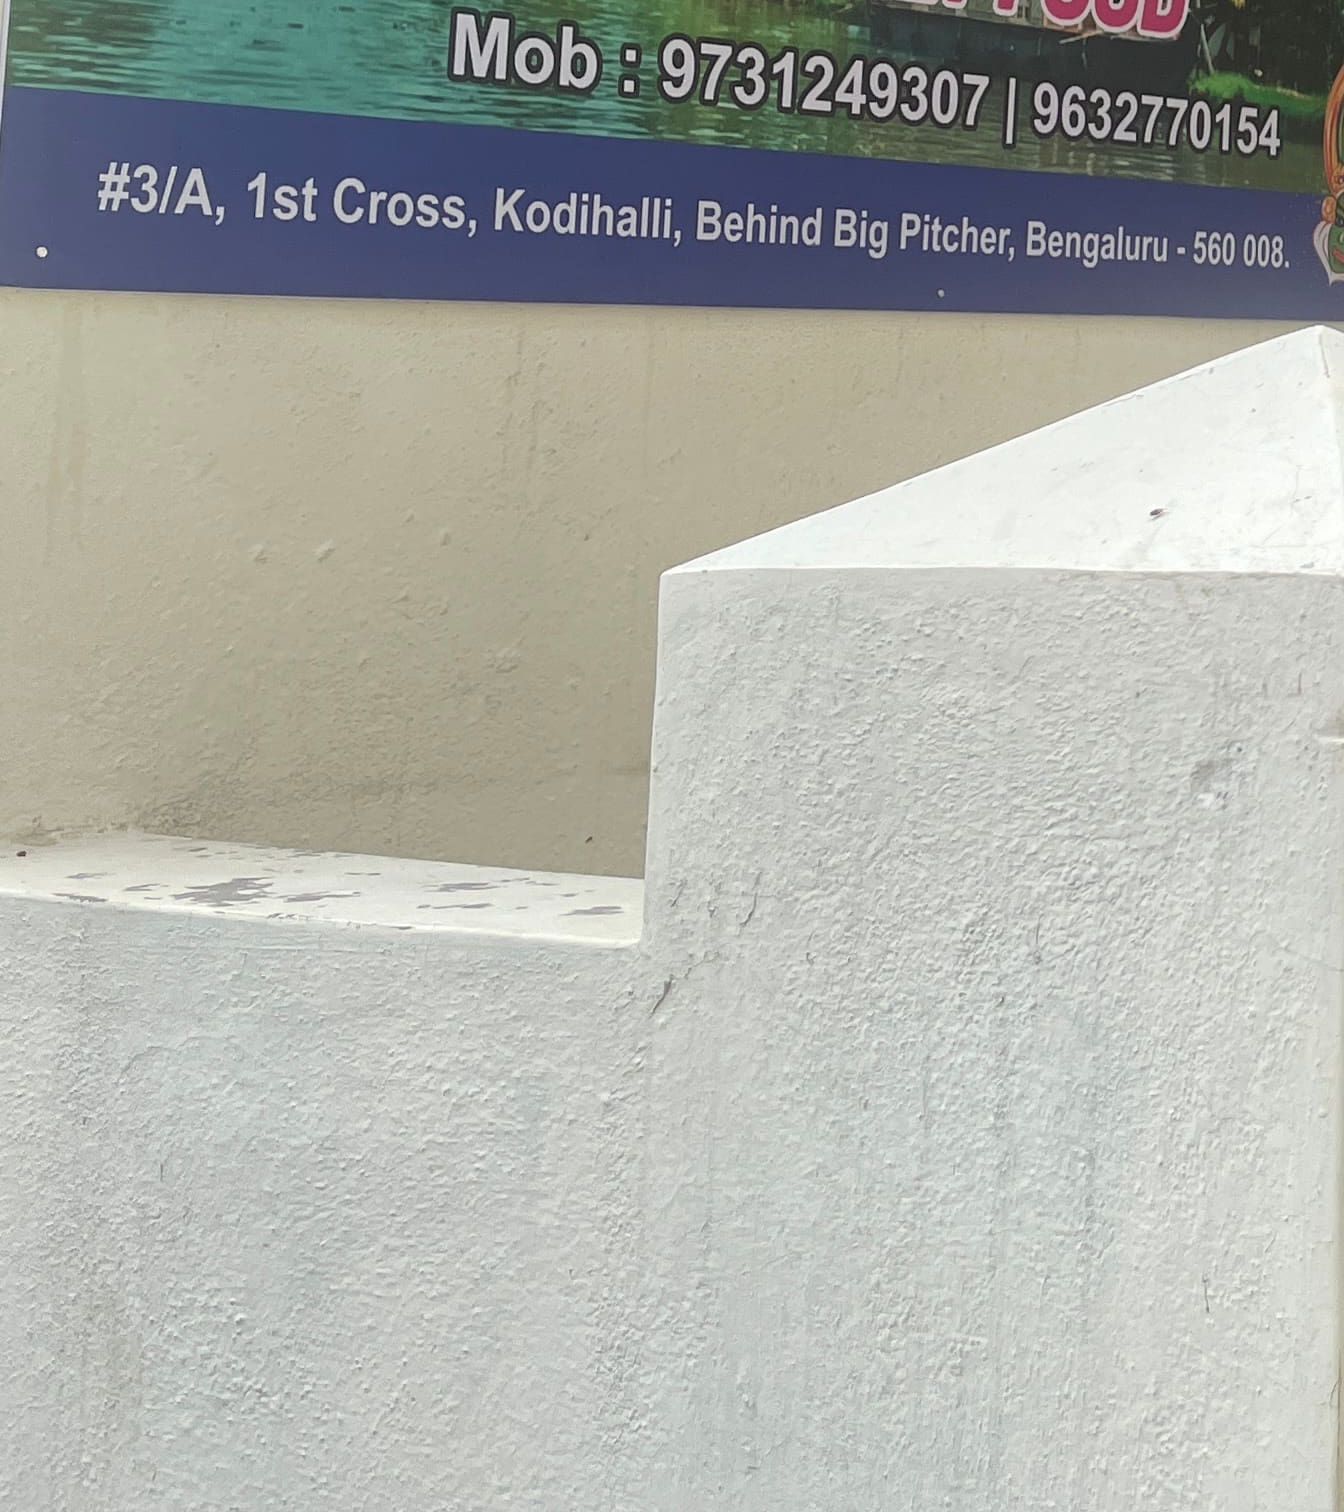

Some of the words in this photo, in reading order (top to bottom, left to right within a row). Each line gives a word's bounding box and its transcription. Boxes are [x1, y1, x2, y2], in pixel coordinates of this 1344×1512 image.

[451, 10, 601, 89] Mob
[660, 37, 990, 127] 9731249307
[1033, 82, 1281, 156] 9632770154
[98, 161, 226, 226] #3/A,
[247, 172, 317, 221] 1st
[333, 177, 477, 237] Cross,
[494, 187, 681, 247] Kodihalli,
[696, 199, 823, 246] Behind
[834, 208, 888, 259] Big
[899, 212, 1015, 262] Pitcher,
[1026, 220, 1168, 268] Bengaluru
[1193, 231, 1235, 265] 560
[1243, 234, 1289, 268] 008.
